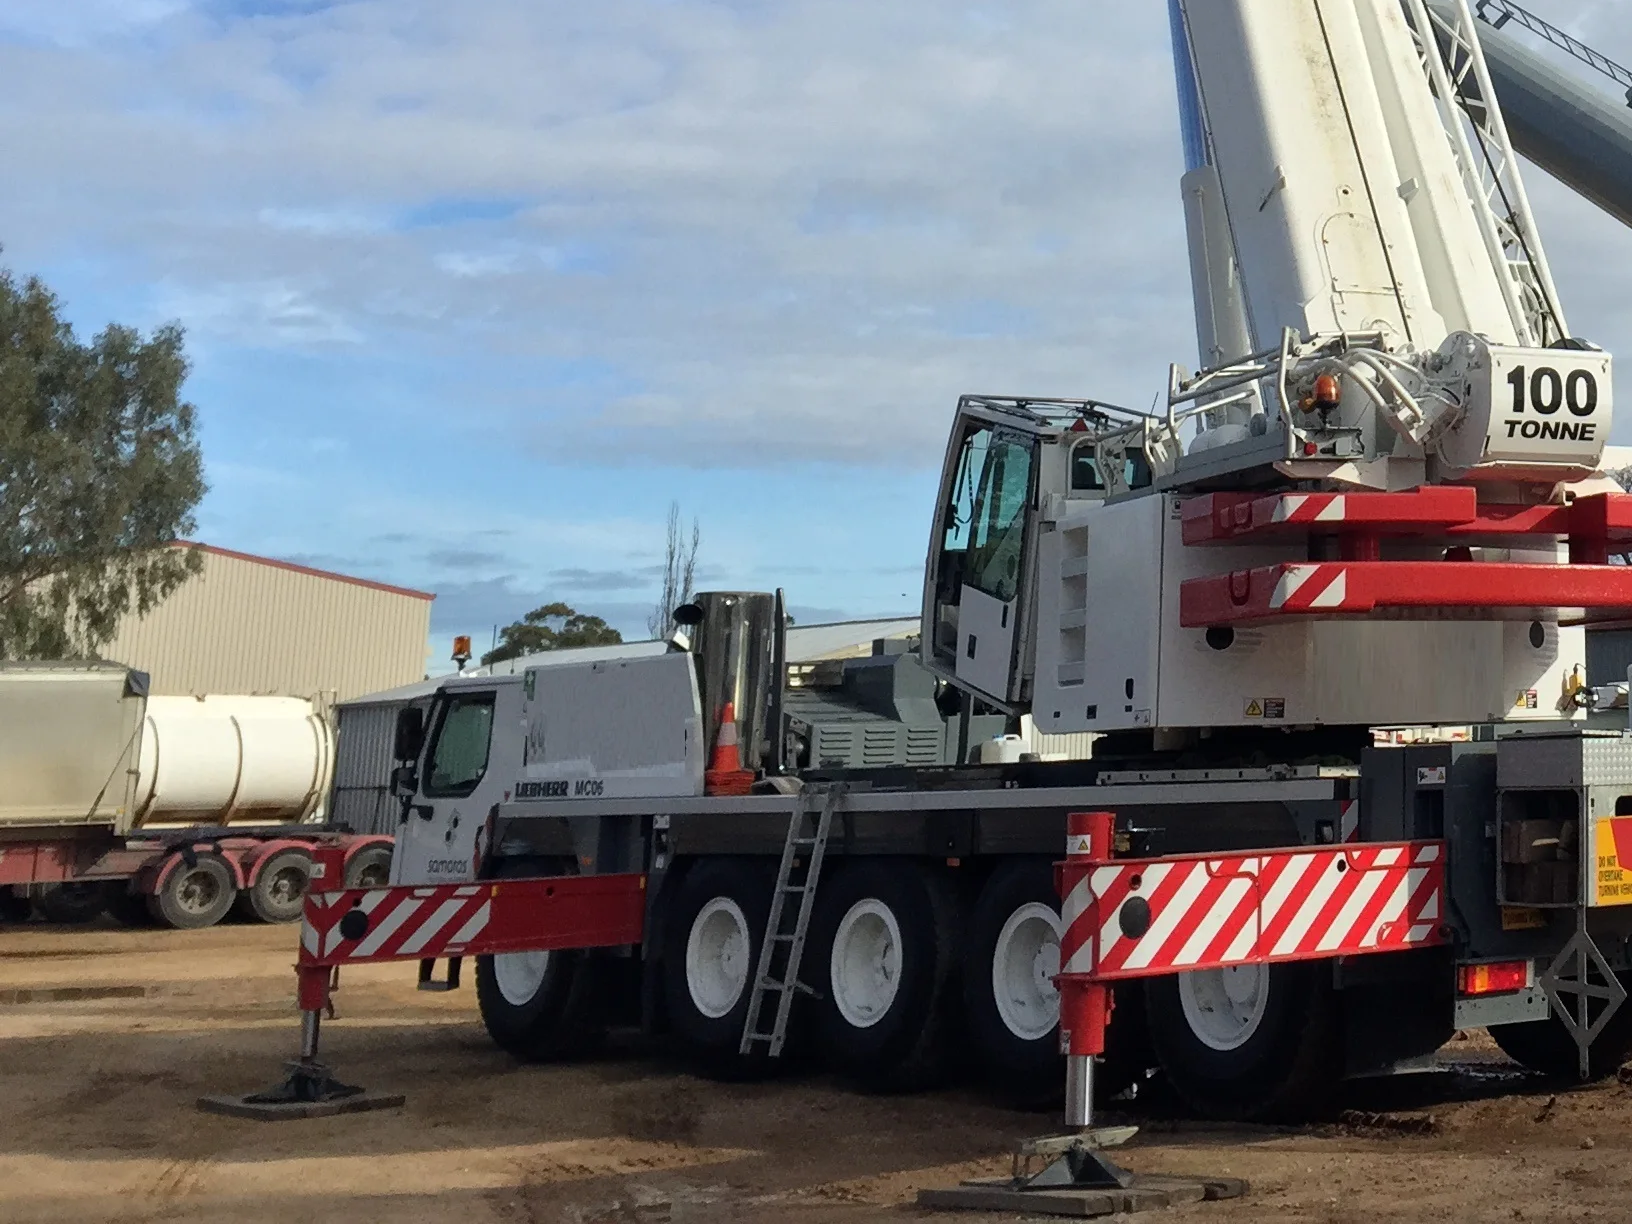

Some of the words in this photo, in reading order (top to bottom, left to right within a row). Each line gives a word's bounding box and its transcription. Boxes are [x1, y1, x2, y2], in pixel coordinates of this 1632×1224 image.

[1507, 364, 1598, 417] 100
[1504, 419, 1597, 441] TONNE
[514, 780, 569, 797] LIEBHERR
